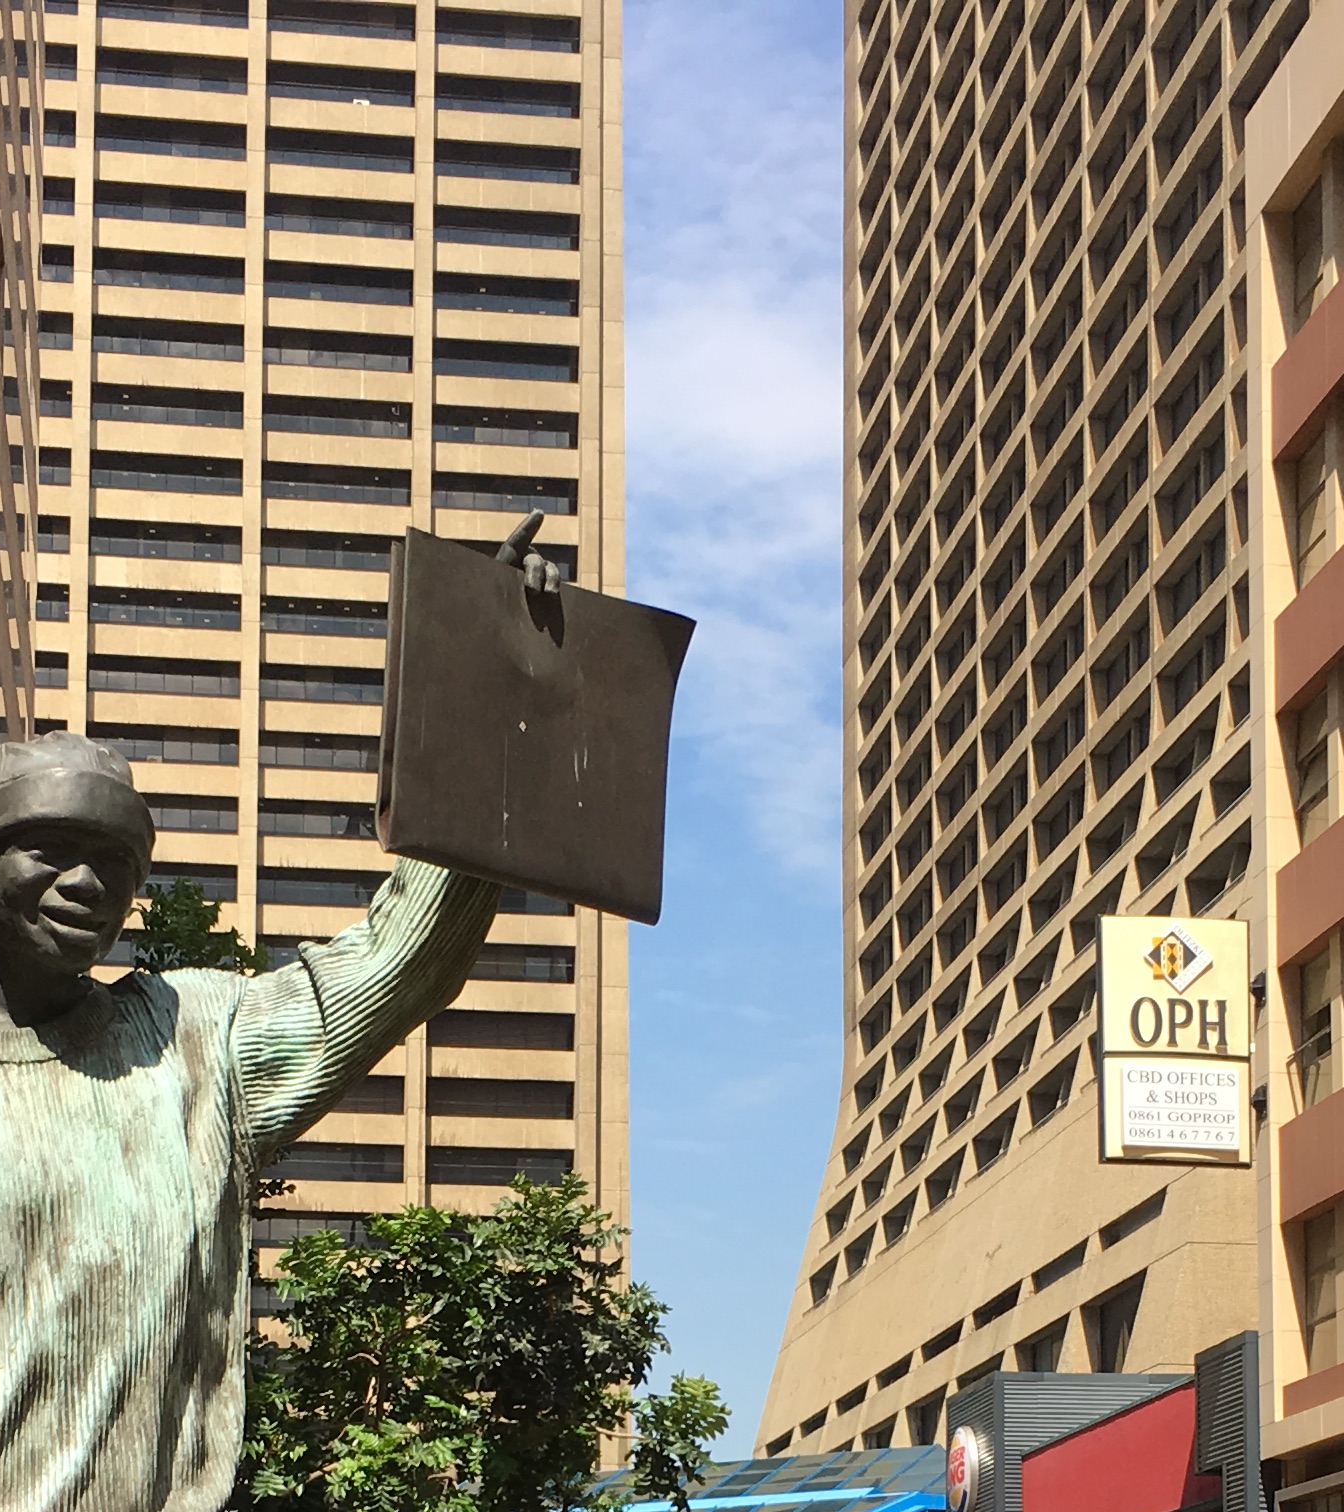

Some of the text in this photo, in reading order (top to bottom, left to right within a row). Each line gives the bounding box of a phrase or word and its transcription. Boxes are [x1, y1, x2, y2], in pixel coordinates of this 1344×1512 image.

[1129, 996, 1228, 1050] OPH
[1127, 1070, 1236, 1087] CBD OFFICES
[1146, 1089, 1218, 1106] & SHOPS
[1128, 1110, 1236, 1124] 0861 GOPROP
[1129, 1127, 1161, 1139] 0861
